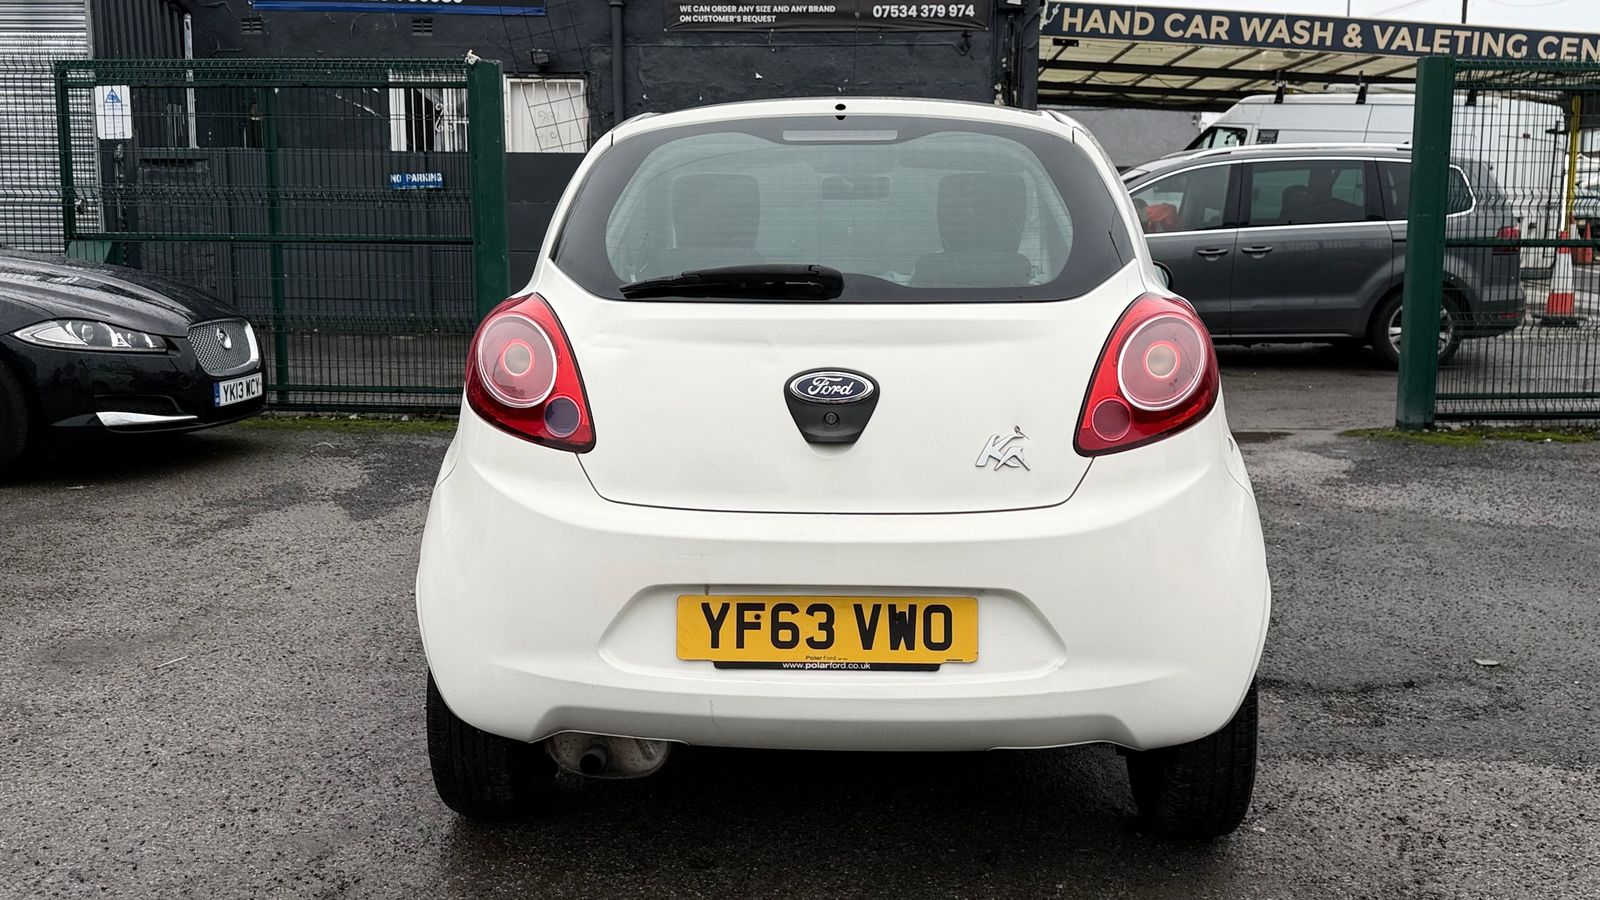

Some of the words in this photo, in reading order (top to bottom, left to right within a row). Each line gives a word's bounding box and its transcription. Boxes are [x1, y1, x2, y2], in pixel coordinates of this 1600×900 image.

[679, 5, 692, 13] WE
[693, 5, 710, 13] CAN
[711, 5, 737, 13] ORDER
[737, 5, 754, 13] ANY
[755, 5, 772, 13] SIZE
[772, 5, 790, 13] AND
[790, 5, 807, 13] ANY
[808, 5, 836, 13] BRAND
[872, 4, 918, 18] 07534
[920, 4, 946, 18] 379
[948, 4, 975, 18] 974
[679, 15, 692, 23] ON
[692, 15, 742, 23] CUSTOMER'S
[742, 15, 777, 23] REQUEST
[1061, 7, 1155, 36] HAND
[1163, 12, 1230, 41] CAR
[1239, 16, 1334, 46] WASH
[1342, 23, 1363, 49] &
[1373, 24, 1528, 59] VALETING
[1537, 35, 1600, 63] CEN
[390, 173, 402, 183] NO
[405, 172, 443, 183] PARKING
[222, 381, 244, 402] YK13
[807, 376, 854, 396] Ford
[700, 602, 835, 650] YF63
[852, 603, 953, 651] VWO
[782, 661, 871, 670] www.polarford.co.uk
